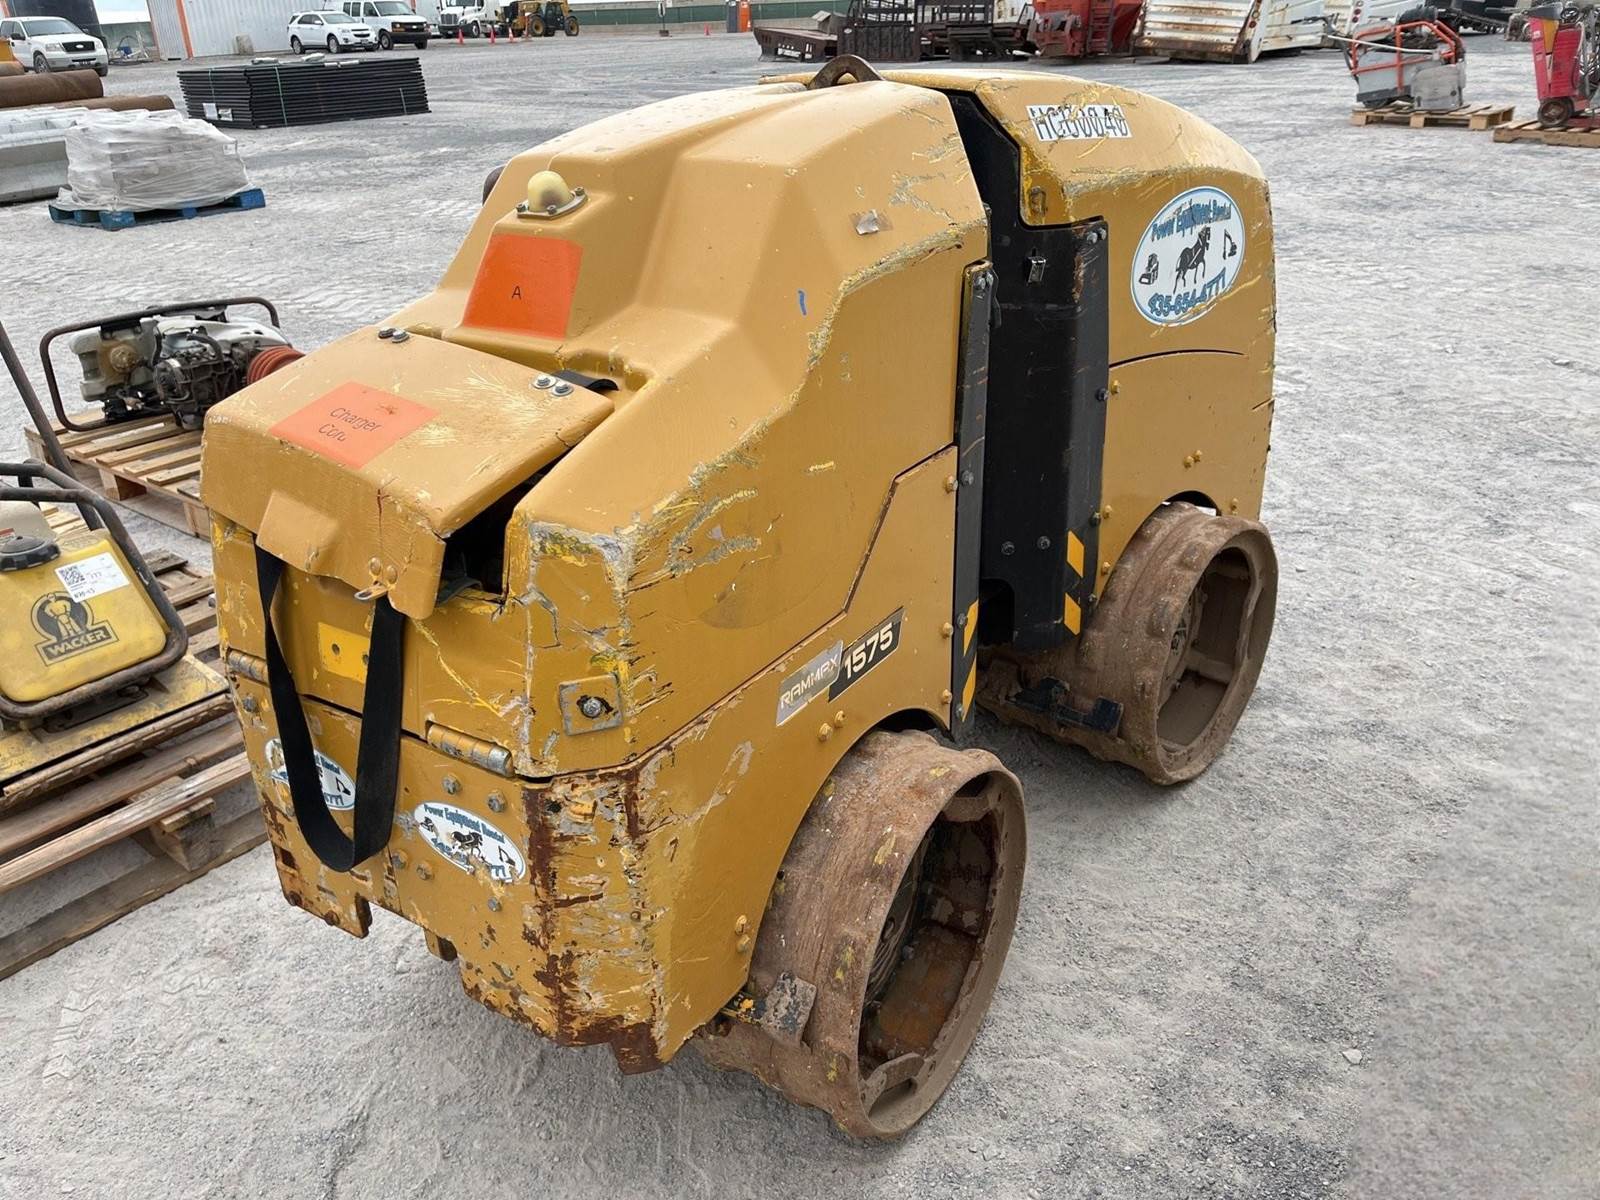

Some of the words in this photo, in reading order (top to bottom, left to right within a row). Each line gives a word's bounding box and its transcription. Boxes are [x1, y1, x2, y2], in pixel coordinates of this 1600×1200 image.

[1151, 219, 1175, 242] Power
[511, 285, 522, 300] A
[330, 407, 383, 432] Charger
[47, 629, 107, 657] WACKER
[844, 623, 893, 679] 1575
[780, 654, 839, 710] RAMMAX
